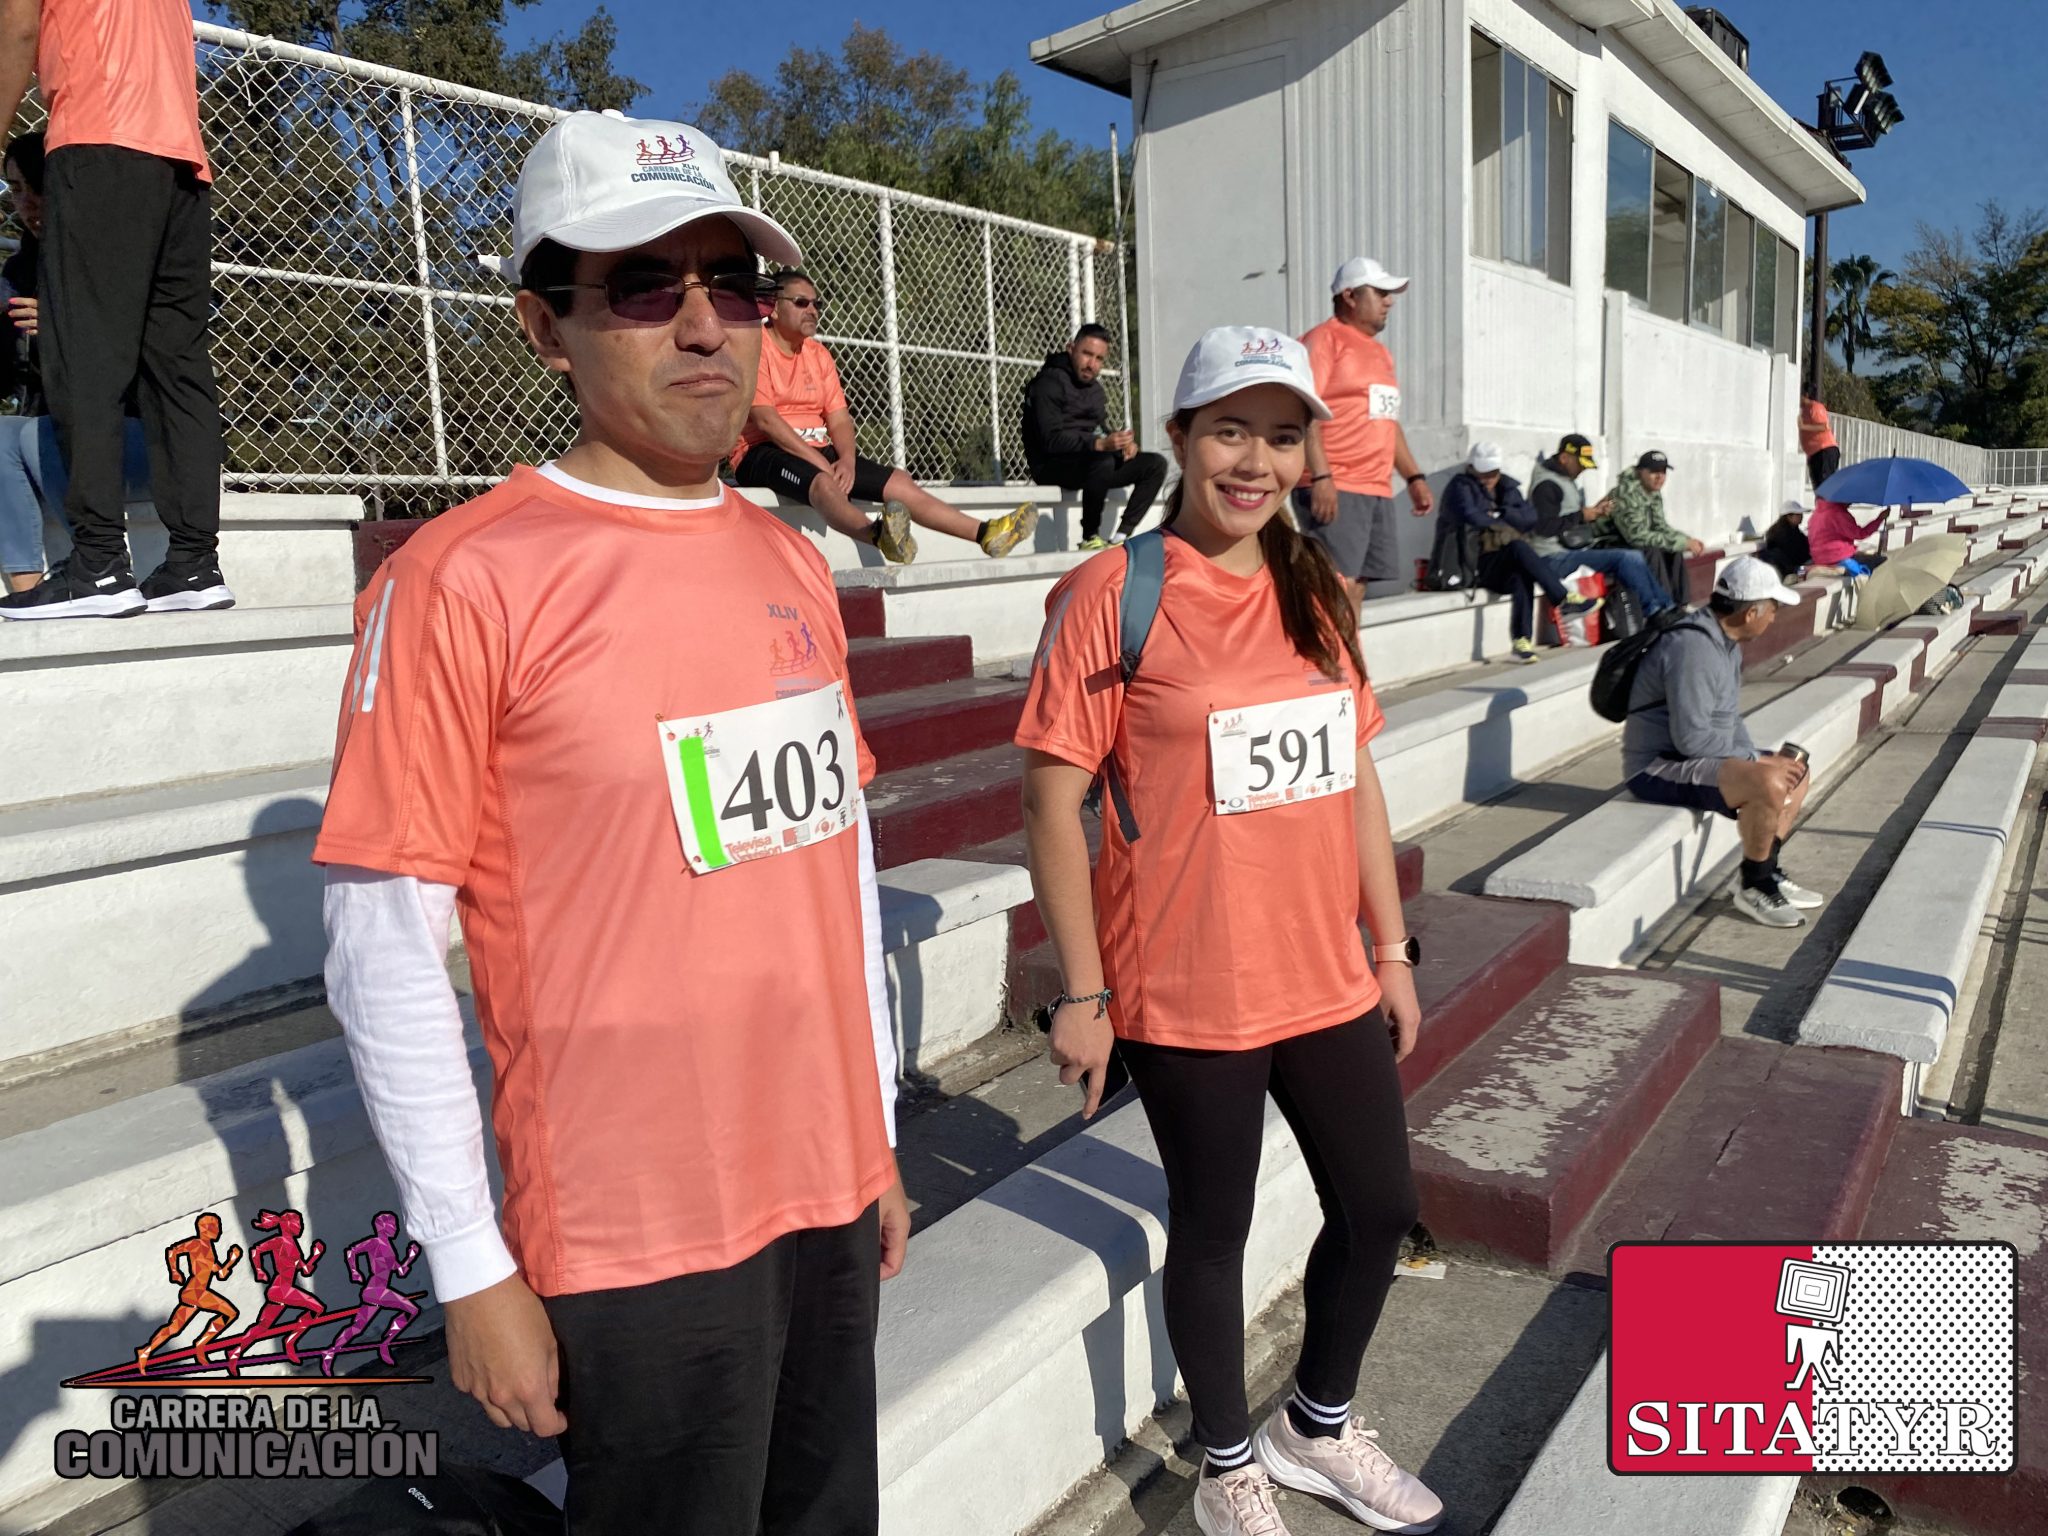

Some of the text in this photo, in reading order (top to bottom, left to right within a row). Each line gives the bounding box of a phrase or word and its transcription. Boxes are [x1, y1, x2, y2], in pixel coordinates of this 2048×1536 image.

[766, 603, 798, 621] XLIV
[1248, 723, 1335, 791] 591
[721, 730, 845, 831] 403
[725, 836, 772, 855] Televisa
[408, 1487, 434, 1510] QUECHUA
